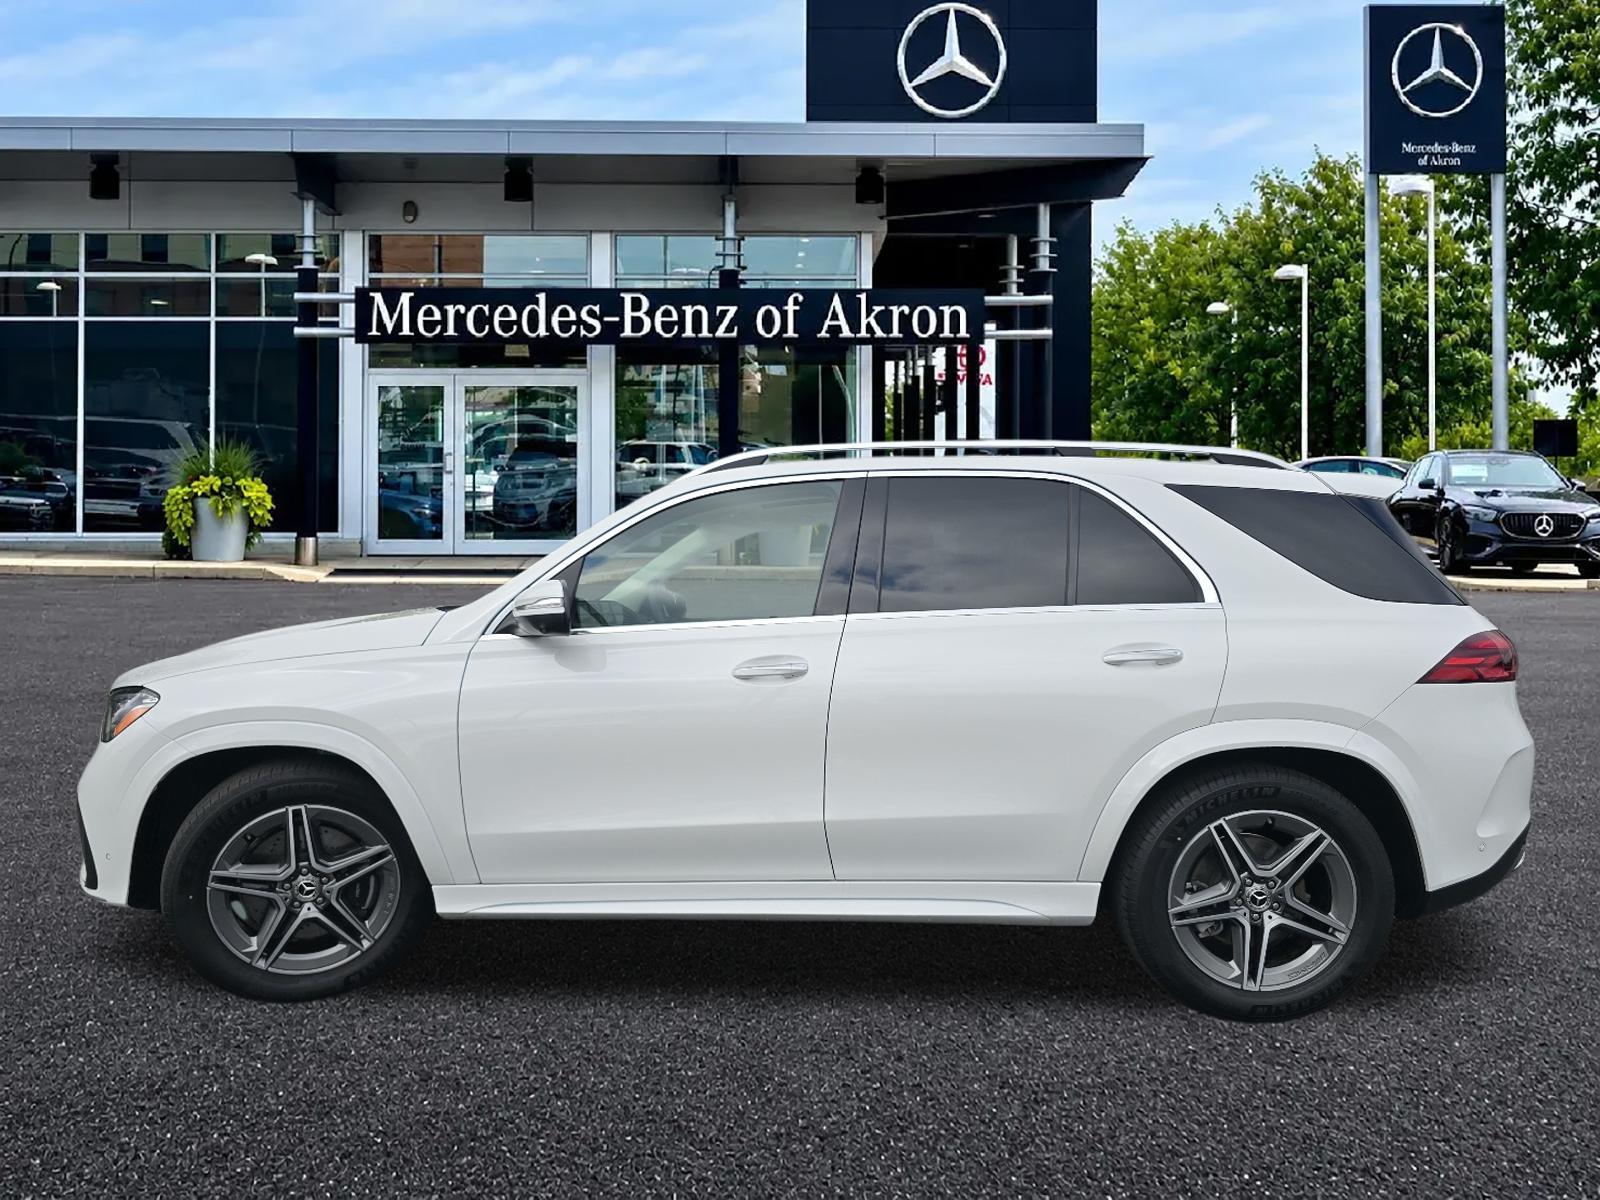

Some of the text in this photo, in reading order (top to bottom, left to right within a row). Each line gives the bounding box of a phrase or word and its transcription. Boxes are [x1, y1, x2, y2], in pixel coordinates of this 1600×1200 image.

[1401, 141, 1477, 154] Mercedes-Benz
[1418, 154, 1461, 166] of Akron
[367, 291, 971, 339] Mercedes-Benz of Akron
[1184, 786, 1277, 825] MICHELIN
